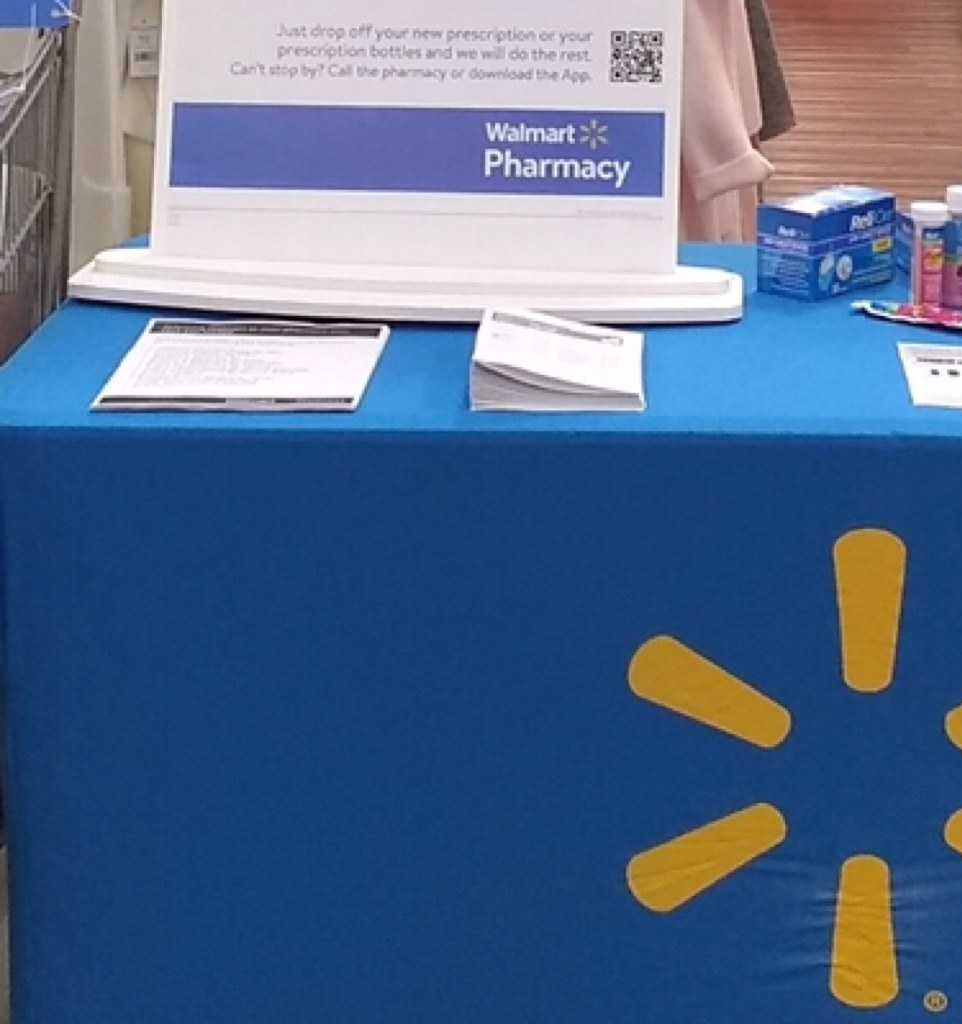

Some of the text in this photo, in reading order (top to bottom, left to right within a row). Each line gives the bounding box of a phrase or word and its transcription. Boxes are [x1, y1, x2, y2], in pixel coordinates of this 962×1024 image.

[276, 23, 593, 45] Just drop off your new prescription or your
[276, 43, 368, 60] prescription
[369, 44, 422, 60] bottles
[425, 45, 453, 60] and
[456, 48, 478, 61] we
[481, 45, 506, 61] will
[508, 46, 530, 62] do
[531, 47, 557, 62] the
[229, 60, 266, 76] Can't
[268, 63, 299, 79] stop
[301, 62, 325, 80] by?
[327, 62, 354, 77] Call
[356, 64, 379, 78] the
[381, 64, 448, 82] pharmacy
[450, 68, 465, 81] or
[469, 66, 533, 81] download
[535, 68, 559, 81] the
[484, 121, 576, 145] Walmart
[484, 147, 632, 189] Pharmacy
